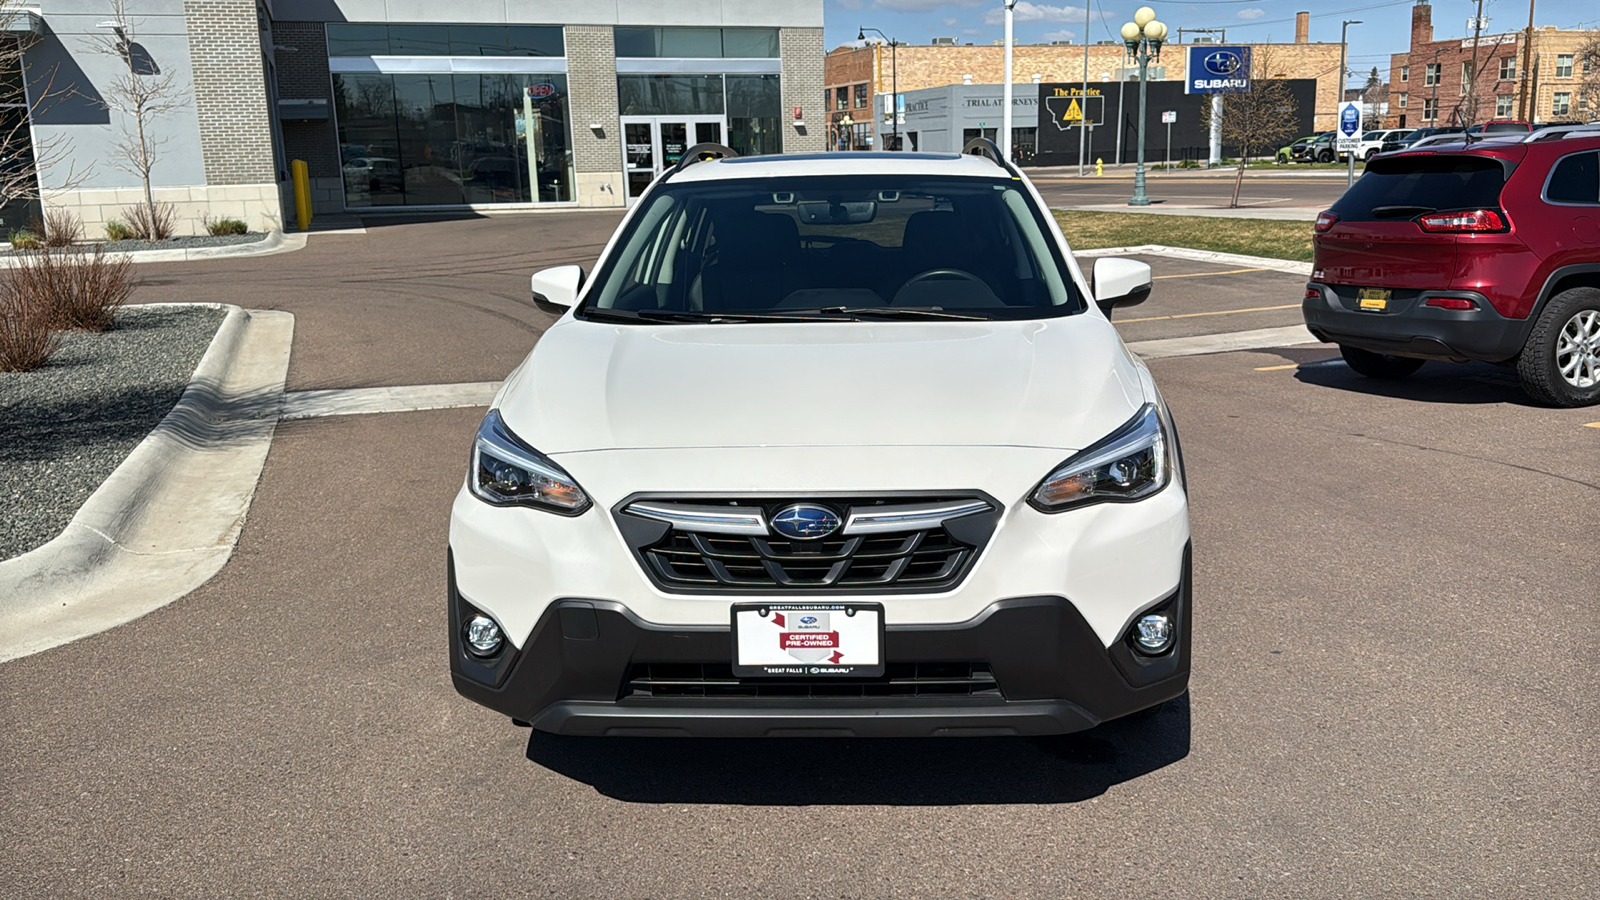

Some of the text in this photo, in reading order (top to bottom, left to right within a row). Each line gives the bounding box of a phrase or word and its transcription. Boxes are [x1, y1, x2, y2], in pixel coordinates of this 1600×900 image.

[1194, 79, 1246, 88] SUBARU
[528, 86, 553, 96] OPEN
[1053, 87, 1101, 96] The Pratice
[967, 98, 1038, 107] TRIAL ATRNEYS
